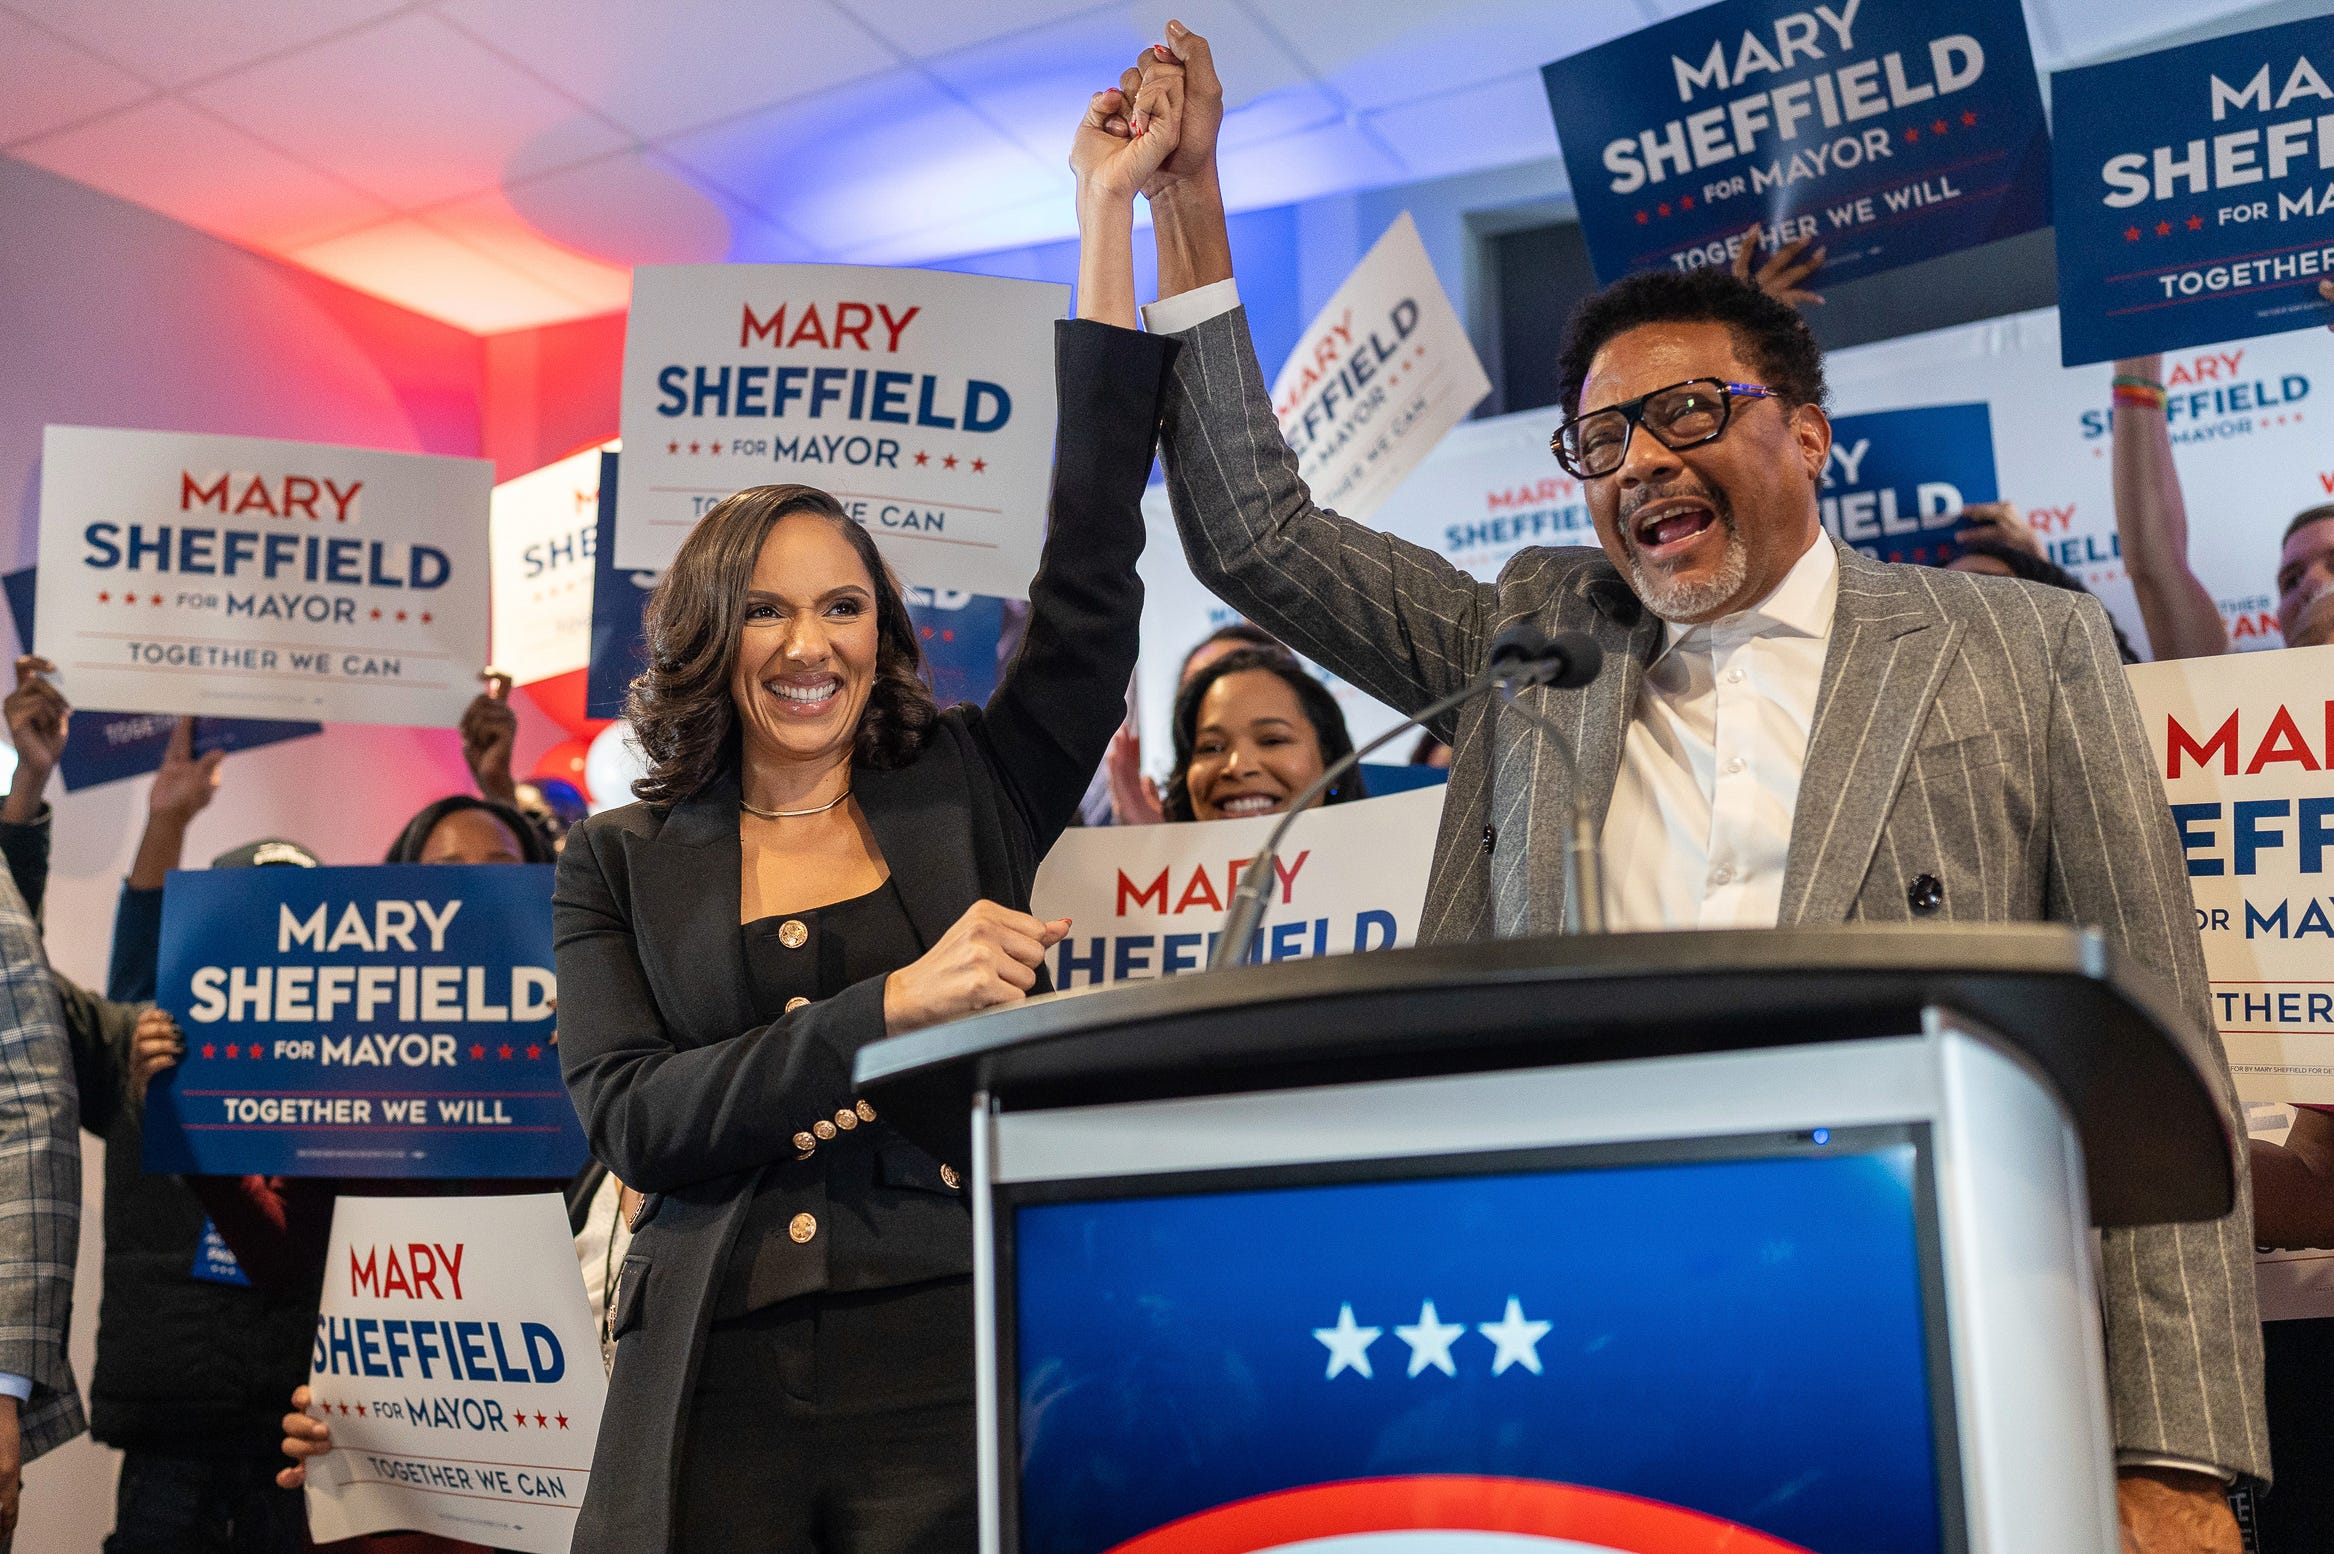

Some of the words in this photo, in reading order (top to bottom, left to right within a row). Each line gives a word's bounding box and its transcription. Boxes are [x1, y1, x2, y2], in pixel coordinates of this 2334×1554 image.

[1671, 0, 1860, 102] MARY
[1602, 34, 1986, 194] SHEFFIELD
[1704, 176, 1747, 204] FOR
[1749, 128, 1893, 196] MAYOR
[1826, 198, 1876, 228] WE
[1882, 176, 1961, 213] WILL
[2218, 202, 2269, 226] FOR
[740, 302, 921, 352] MARY
[656, 365, 1012, 433] SHEFFIELD
[732, 439, 767, 456] FOR
[774, 435, 900, 468] MAYOR
[180, 470, 363, 522] MARY
[881, 505, 945, 532] CAN
[84, 522, 451, 589] SHEFFIELD
[176, 592, 218, 610] FOR
[226, 593, 355, 624] MAYOR
[129, 643, 278, 670] TOGETHER
[294, 651, 331, 675] WE
[343, 654, 401, 677] CAN
[2167, 700, 2334, 779] MA
[278, 900, 463, 953] MARY
[2244, 897, 2334, 939] MA
[188, 966, 557, 1024] SHEFFIELD
[274, 1040, 316, 1060] FOR
[321, 1033, 458, 1067] MAYOR
[224, 1098, 371, 1124] TOGETHER
[381, 1100, 427, 1124] WE
[438, 1100, 512, 1124] WILL
[350, 1243, 464, 1300] MARY
[313, 1314, 566, 1384] SHEFFIELD
[372, 1401, 404, 1419] FOR
[404, 1397, 509, 1432] MAYOR
[367, 1456, 472, 1490] TOGETHER
[475, 1470, 513, 1495] WE
[517, 1474, 567, 1499] CAN
